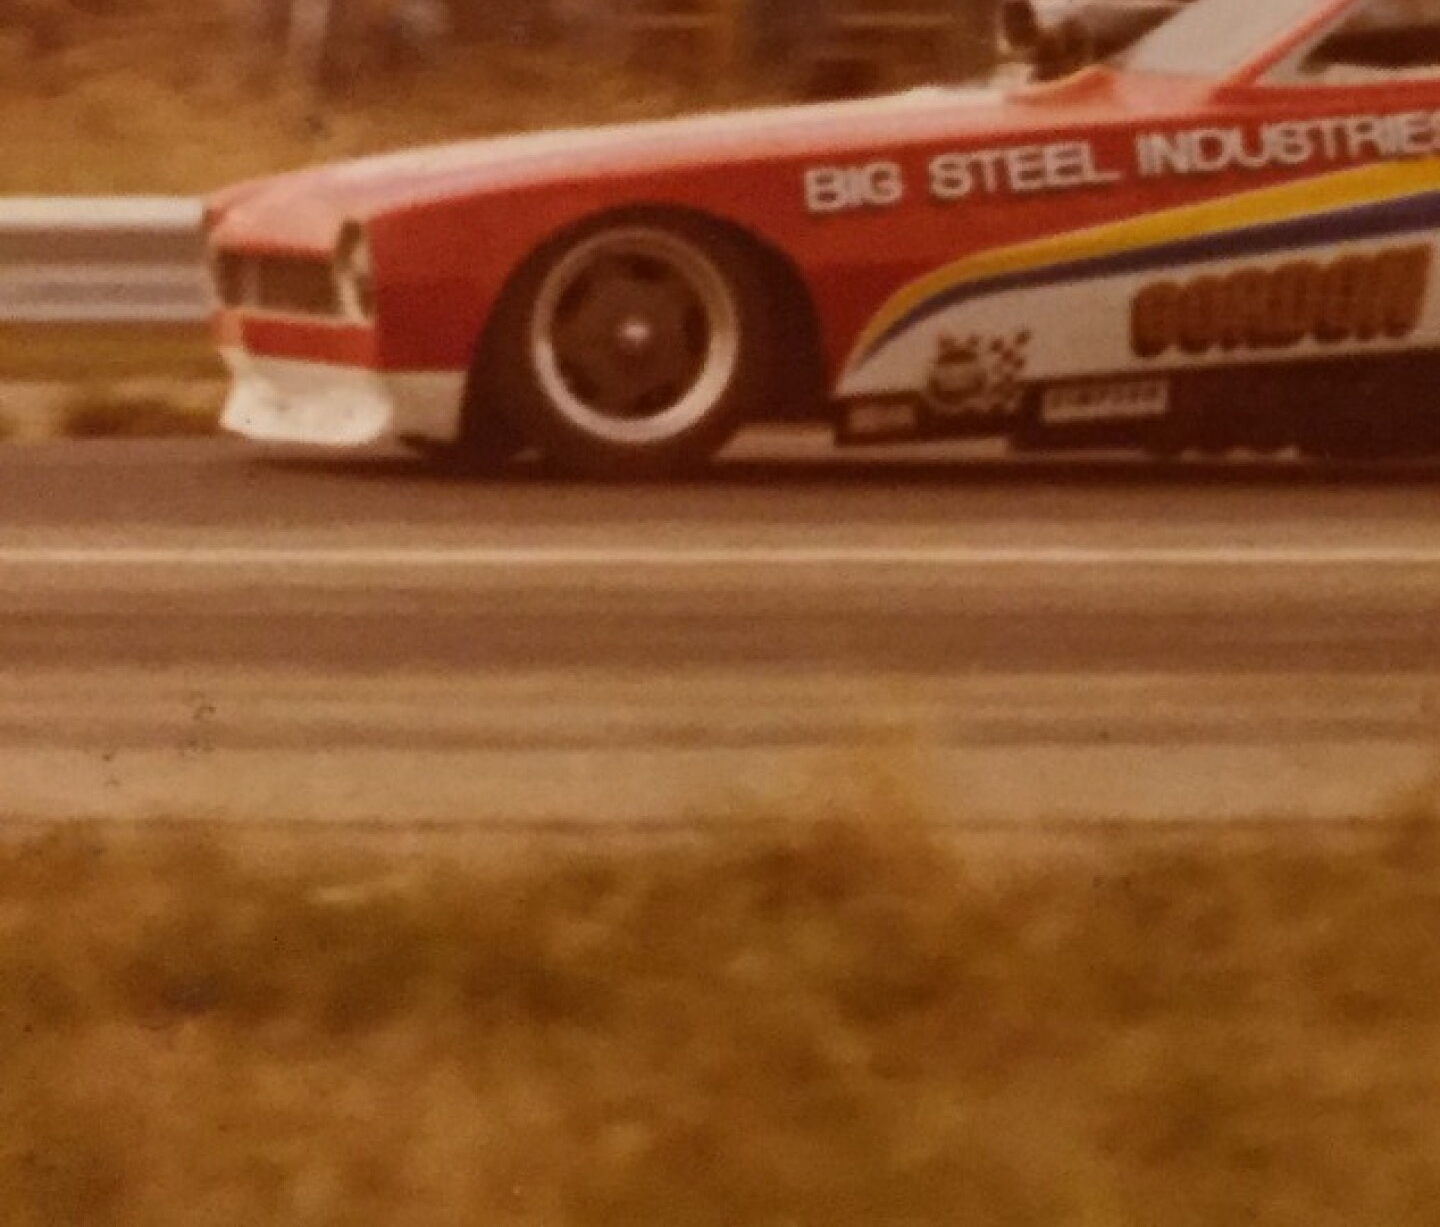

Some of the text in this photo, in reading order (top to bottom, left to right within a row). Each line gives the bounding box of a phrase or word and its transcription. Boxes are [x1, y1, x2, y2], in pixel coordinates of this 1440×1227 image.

[803, 160, 902, 213] BIG
[926, 139, 1119, 199] STEEL
[1130, 243, 1434, 359] GORDON
